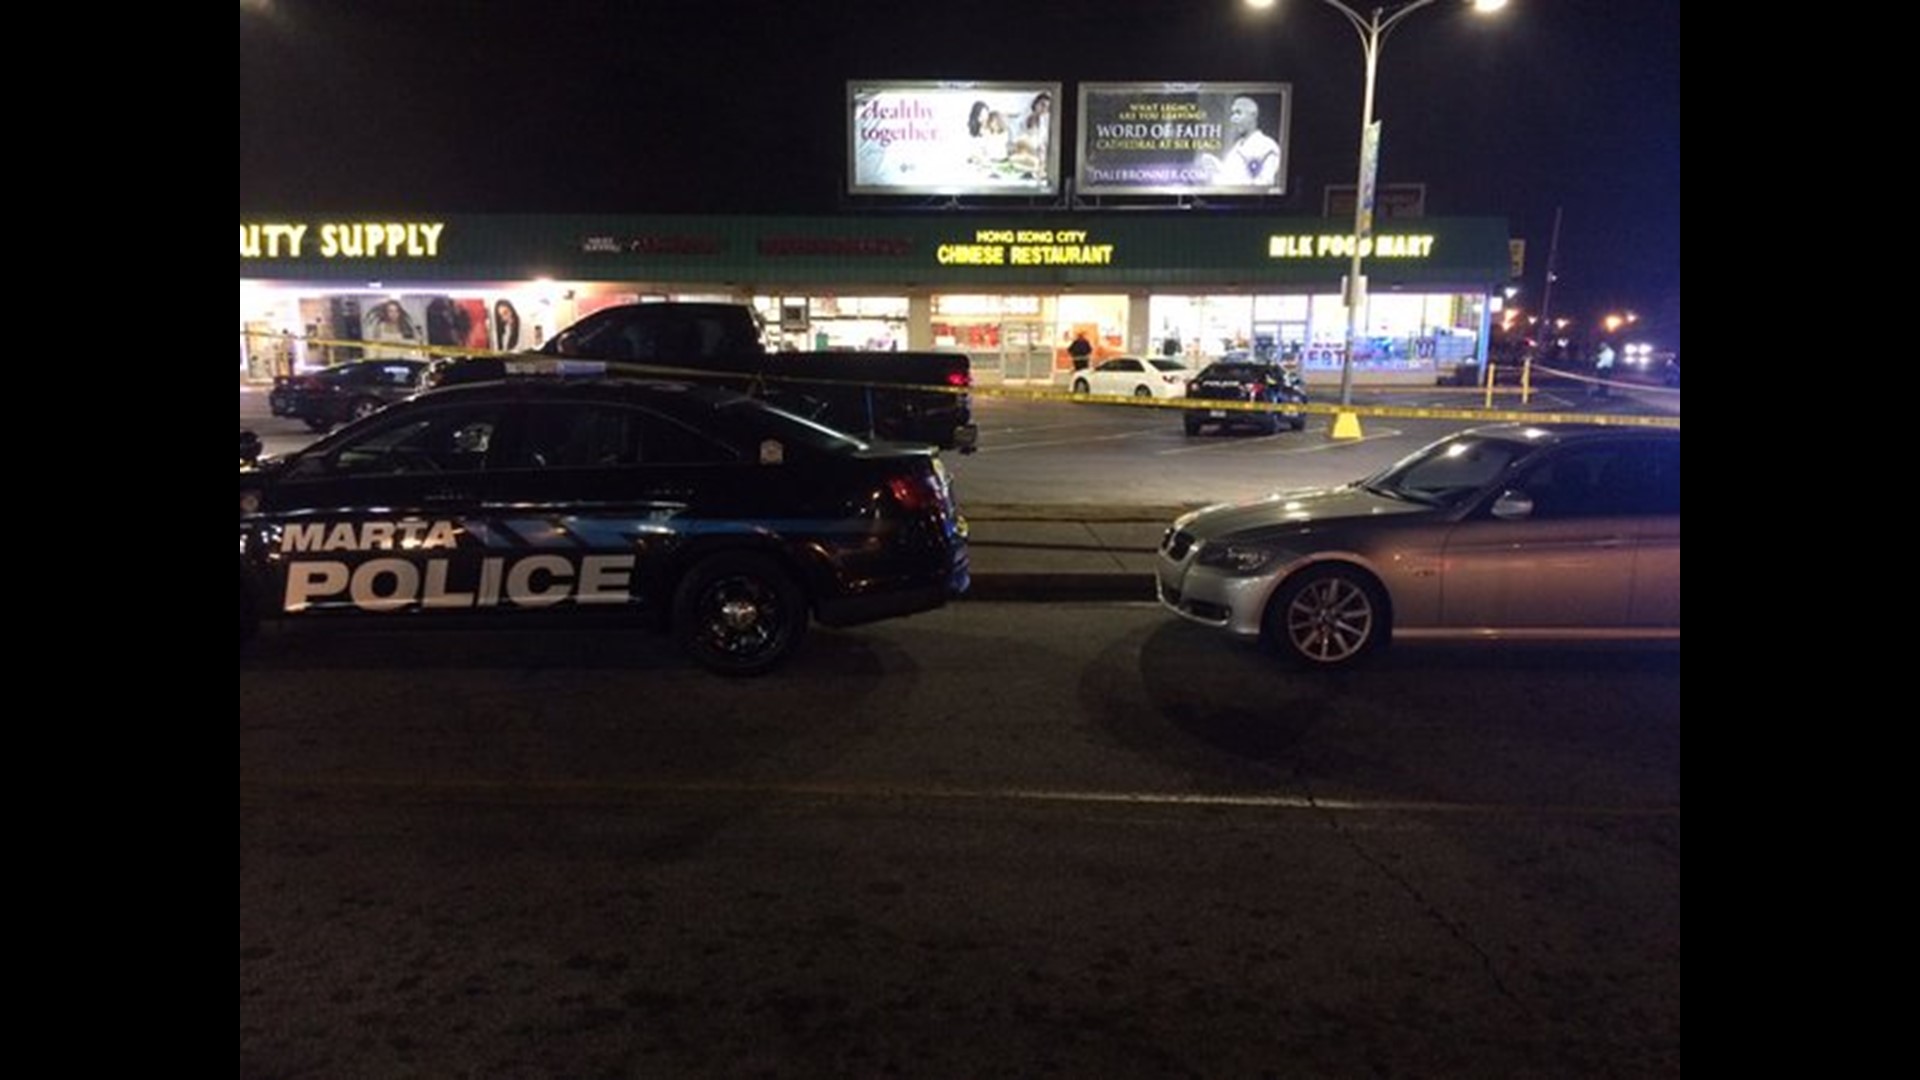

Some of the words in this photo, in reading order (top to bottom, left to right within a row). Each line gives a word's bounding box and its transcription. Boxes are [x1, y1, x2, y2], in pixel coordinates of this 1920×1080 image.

[1096, 124, 1147, 138] WORD
[1150, 123, 1173, 139] OF
[1176, 123, 1222, 137] FAITH
[320, 223, 444, 257] SUPPLY
[976, 231, 1014, 242] HONG
[1017, 231, 1053, 242] KONG
[1056, 231, 1086, 242] CITY
[1269, 235, 1313, 257] MLK
[1375, 235, 1434, 257] MART
[937, 245, 1004, 264] CHINESE
[1010, 245, 1113, 264] RESTAURANT
[281, 520, 458, 553] MARTA
[284, 554, 636, 612] POLICE
